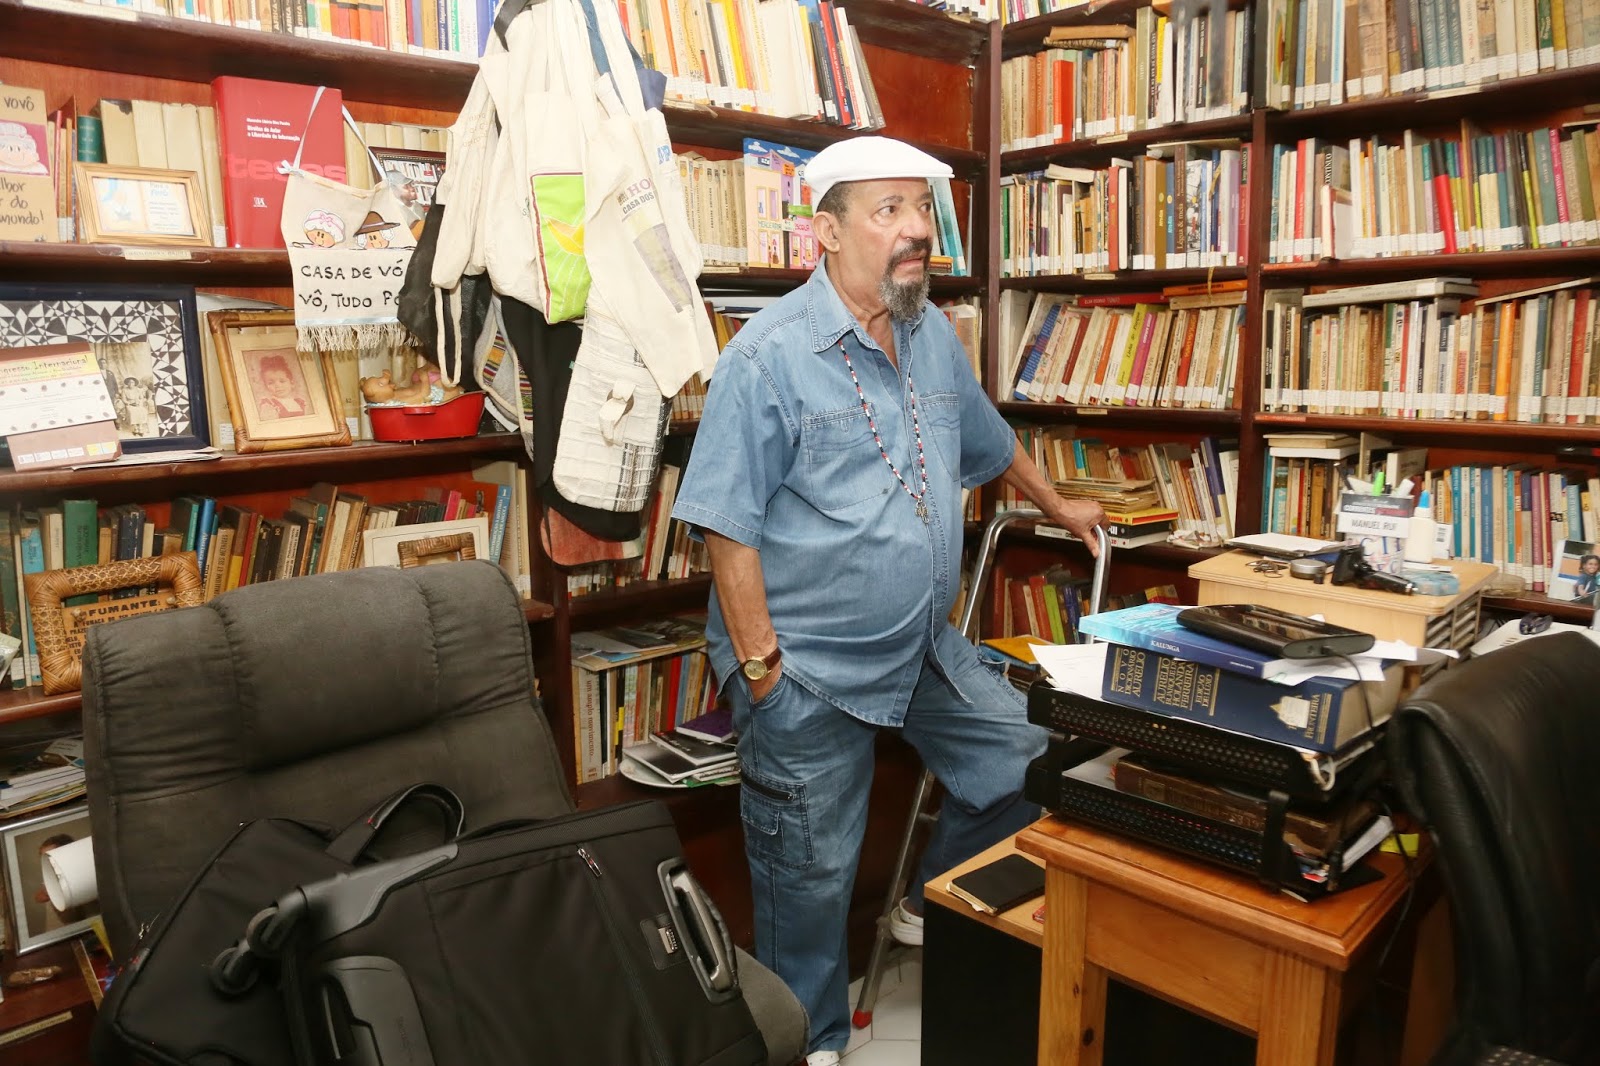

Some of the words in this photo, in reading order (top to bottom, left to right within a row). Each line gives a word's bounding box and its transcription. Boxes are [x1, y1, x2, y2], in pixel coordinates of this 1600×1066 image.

[622, 199, 641, 214] CASA
[639, 192, 655, 203] DOS
[1177, 229, 1185, 249] Légua
[300, 265, 345, 280] CASA
[351, 266, 373, 279] DE
[331, 292, 372, 308] TUDO
[1352, 519, 1381, 530] MANUEL
[89, 599, 161, 617] FUMANTE:
[1151, 639, 1180, 652] KALUNGA
[1125, 650, 1136, 695] DICIONÁRIO
[586, 680, 595, 692] um
[1172, 661, 1186, 707] HOLANDA
[1180, 663, 1194, 708] FERREIRA
[585, 693, 596, 716] amplo
